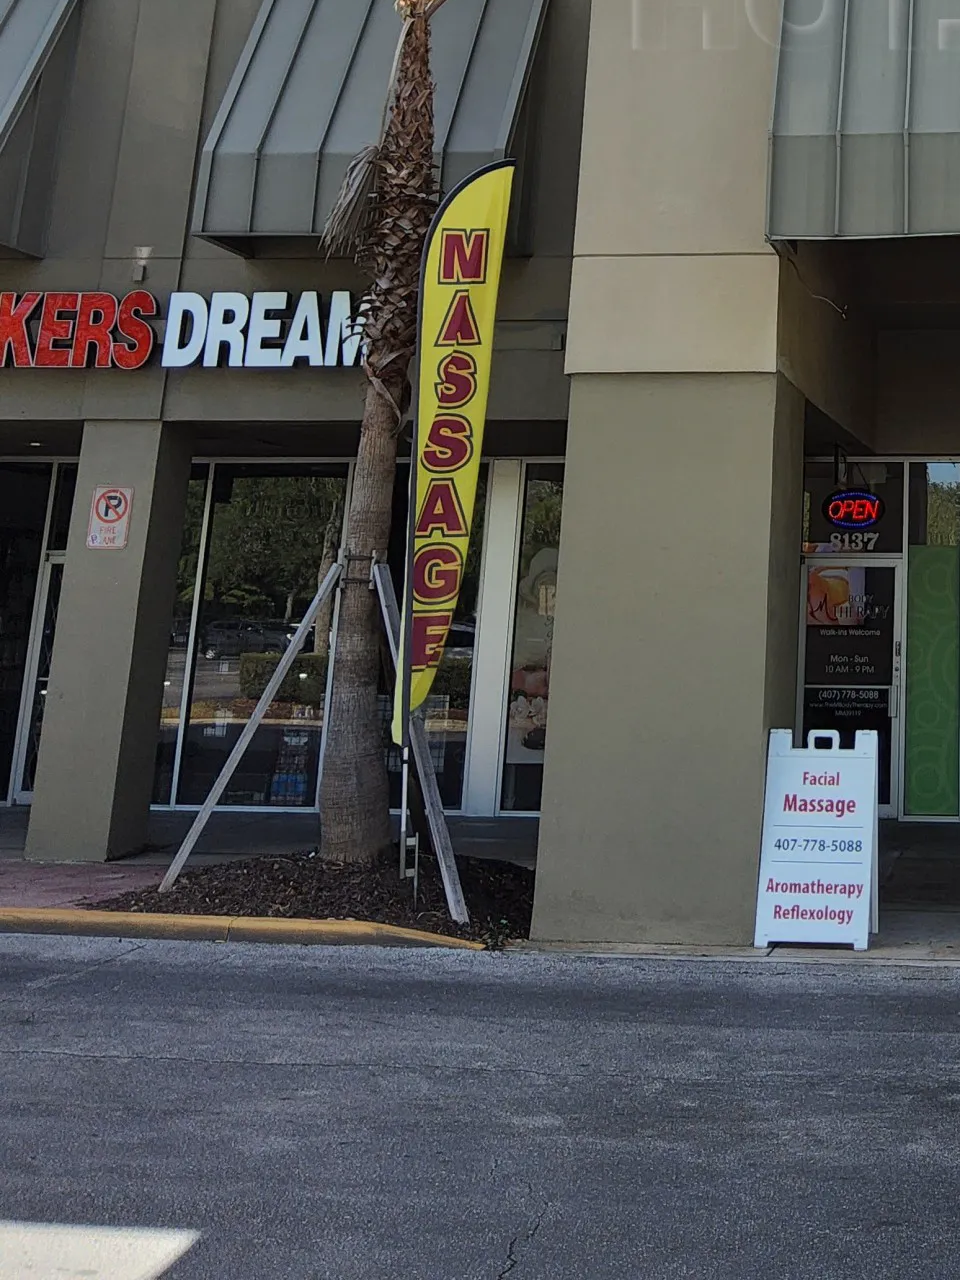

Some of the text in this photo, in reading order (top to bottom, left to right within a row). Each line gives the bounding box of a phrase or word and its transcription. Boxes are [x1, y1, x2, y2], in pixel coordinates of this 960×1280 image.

[0, 289, 157, 370] KERS
[412, 227, 490, 673] MASSAGE
[828, 500, 879, 519] OPEN
[830, 532, 880, 551] 8137
[849, 628, 881, 636] Welcome
[830, 654, 848, 662] Mon
[854, 654, 869, 663] Sun
[825, 665, 834, 673] 10
[836, 665, 848, 673] AM
[855, 665, 861, 673] 9
[862, 665, 875, 674] PM
[818, 690, 879, 701] (407) 778-5088
[802, 771, 841, 787] Facial
[782, 793, 857, 818] Massage
[774, 838, 864, 853] 407-778-5088
[765, 877, 865, 899] Aromatherapy
[772, 904, 854, 925] Reflexology
